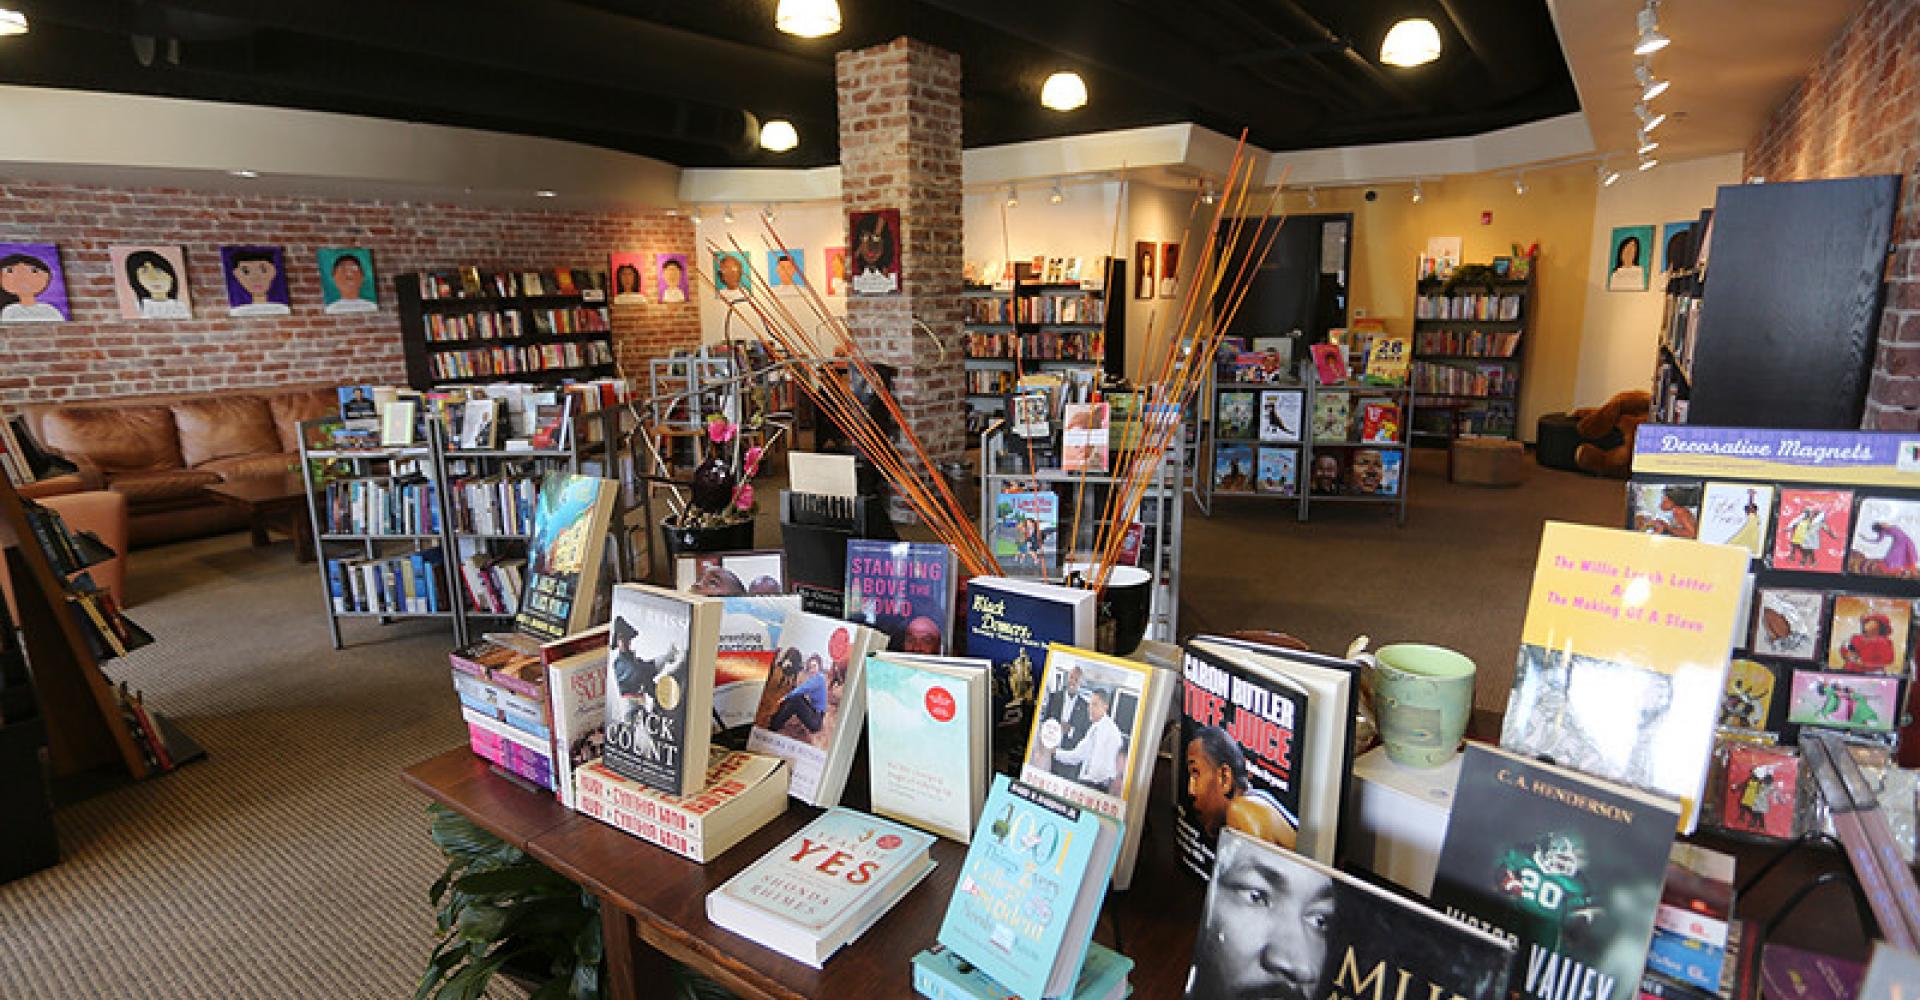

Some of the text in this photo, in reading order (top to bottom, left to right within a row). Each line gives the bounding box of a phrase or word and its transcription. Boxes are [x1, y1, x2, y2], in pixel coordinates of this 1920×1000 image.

[1661, 435, 1873, 464] Decorative Magnets
[851, 557, 942, 580] STANDING
[1554, 555, 1575, 571] The
[1580, 560, 1618, 578] Willie
[1669, 573, 1713, 593] Letter
[851, 577, 908, 599] ABOVE
[972, 594, 1006, 616] Black
[1548, 591, 1568, 606] The
[1572, 596, 1620, 620] Making
[719, 632, 762, 644] arenting
[1184, 652, 1294, 730] CARON BUTLER
[1183, 679, 1293, 770] TUFF JUICE
[1532, 779, 1634, 825] HENDERSON
[789, 838, 880, 885] YES
[1520, 868, 1564, 910] 20
